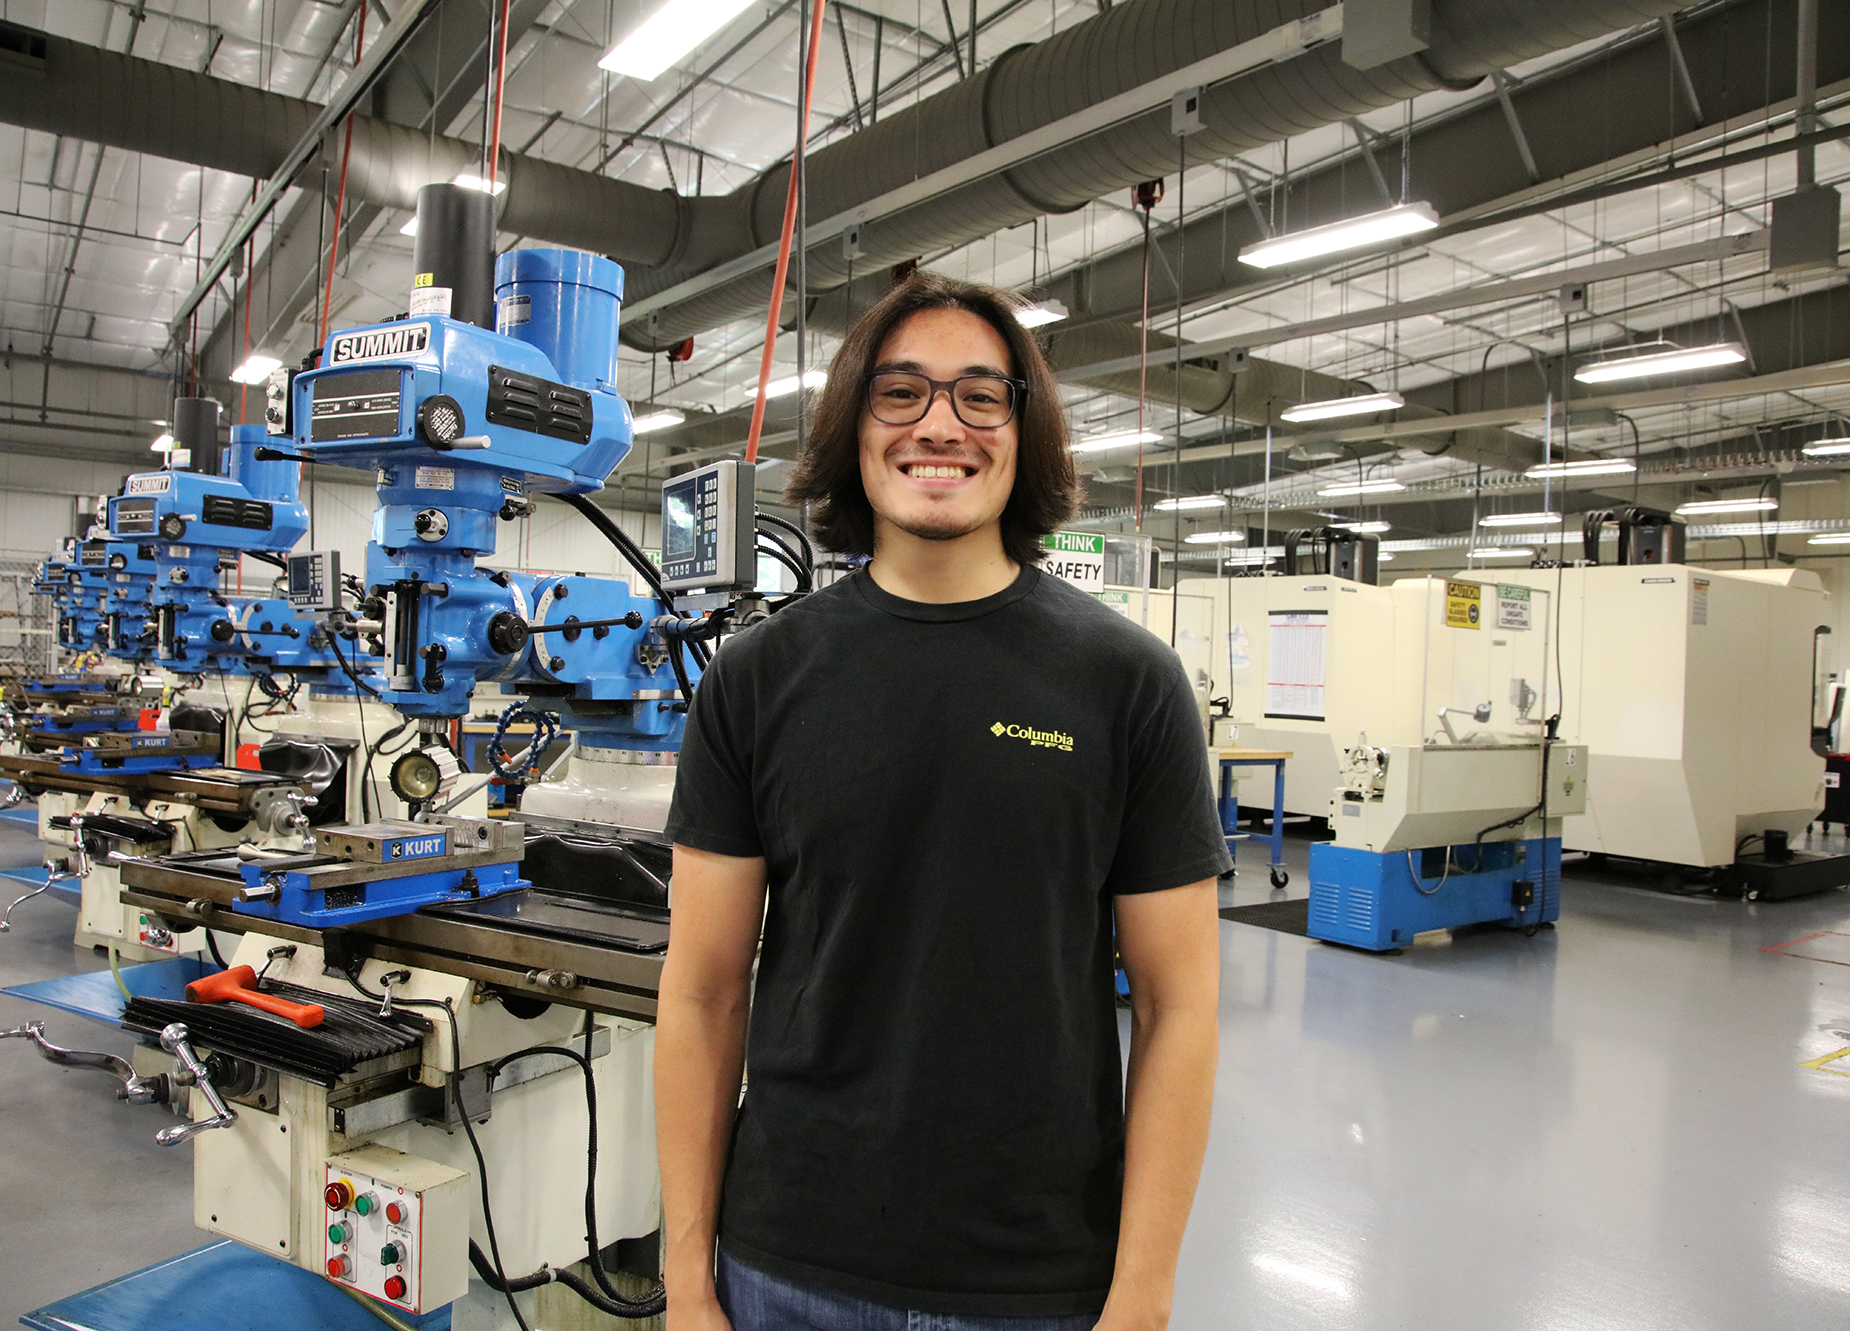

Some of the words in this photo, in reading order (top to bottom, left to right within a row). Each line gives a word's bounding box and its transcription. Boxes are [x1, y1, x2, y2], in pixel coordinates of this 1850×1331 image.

[337, 328, 424, 361] SUMMIT
[130, 479, 169, 493] SUMMIT
[1053, 534, 1096, 552] THINK
[1046, 561, 1102, 580] SAFETY
[1448, 583, 1480, 599] CAUTION
[1501, 618, 1528, 626] CONDITIONS
[144, 738, 167, 746] KURT
[1006, 724, 1074, 746] Columbia
[405, 838, 442, 856] KURT
